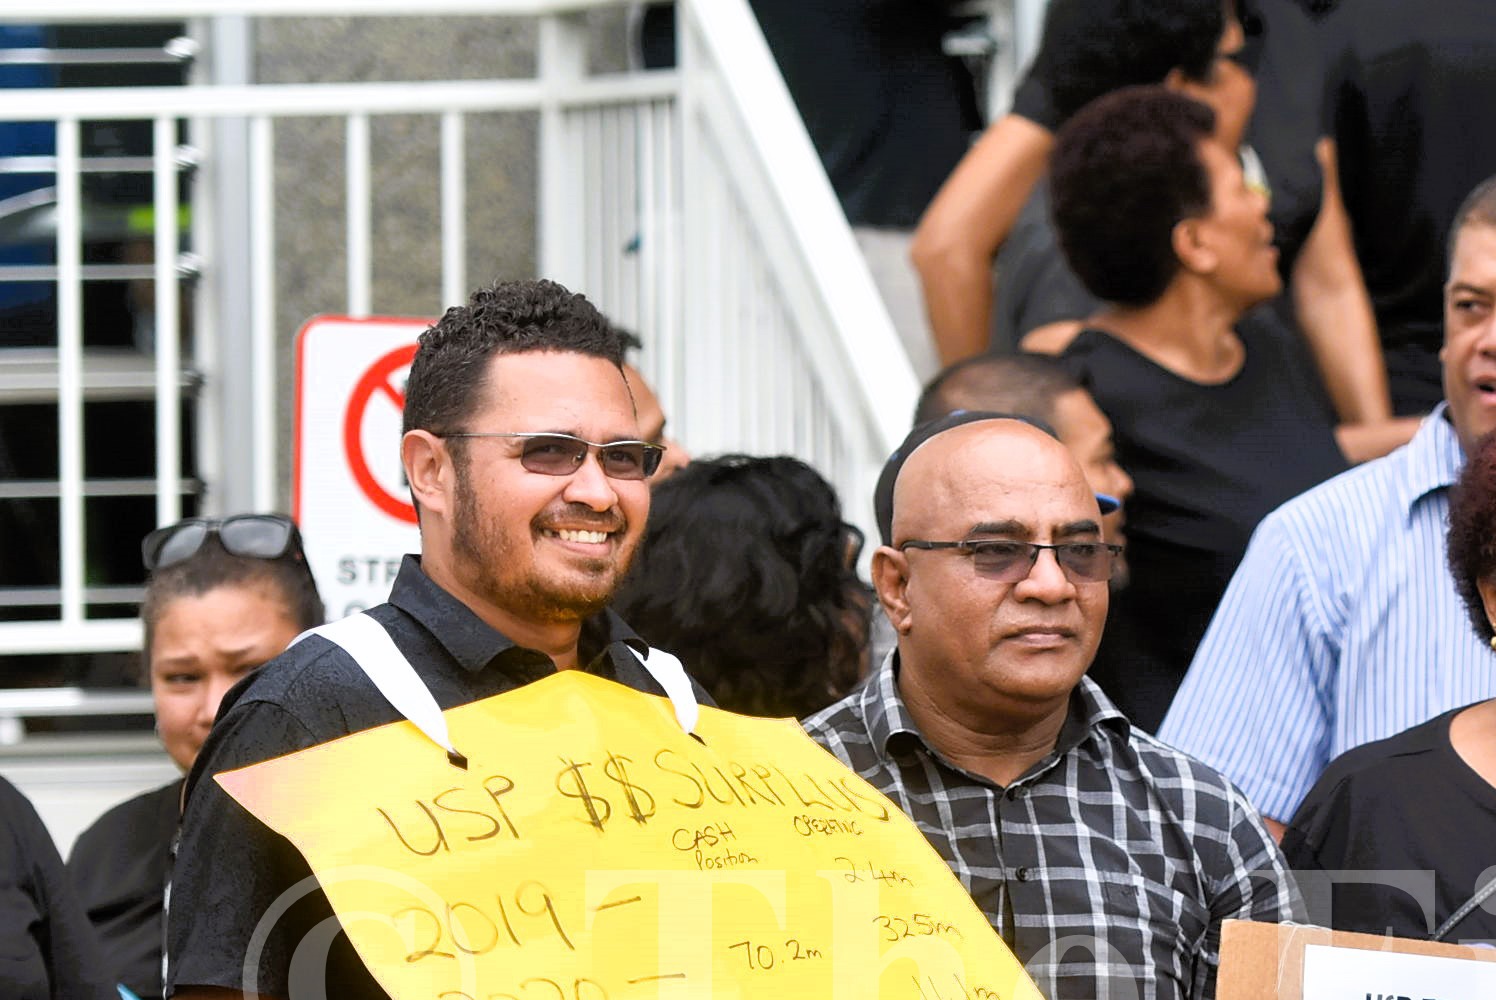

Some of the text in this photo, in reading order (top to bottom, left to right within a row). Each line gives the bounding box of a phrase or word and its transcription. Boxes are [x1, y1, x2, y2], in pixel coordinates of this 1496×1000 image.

[375, 775, 520, 856] USP
[672, 822, 737, 851] CASH
[695, 848, 759, 871] Position
[392, 880, 576, 963] 2019
[729, 939, 823, 970] 70.2m
